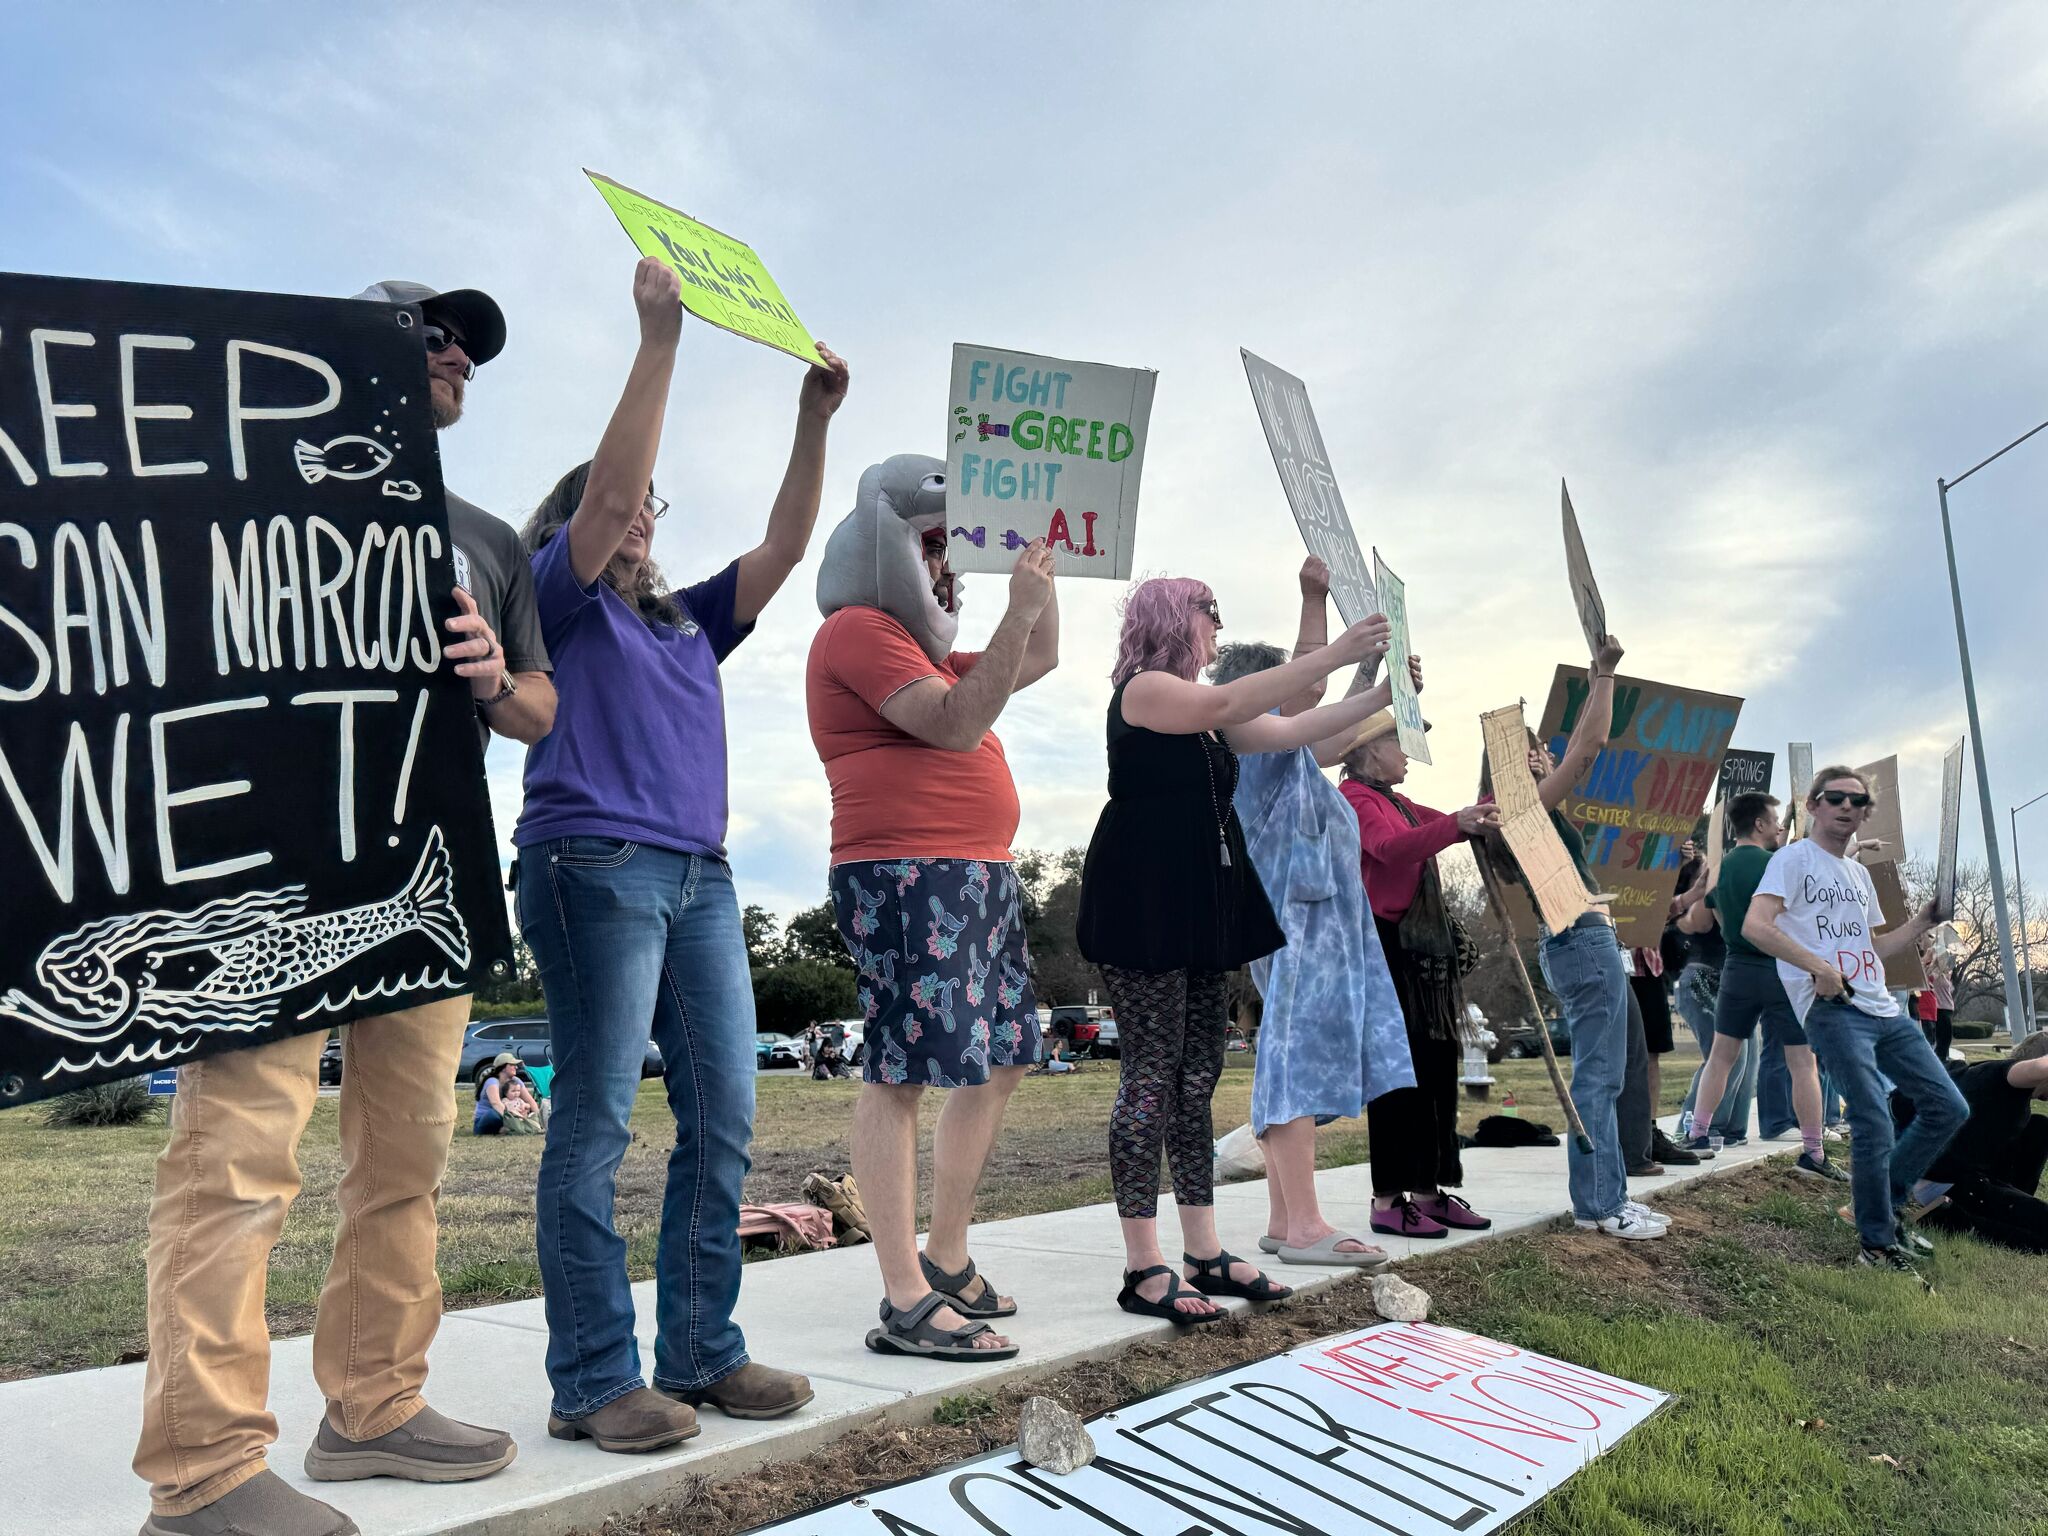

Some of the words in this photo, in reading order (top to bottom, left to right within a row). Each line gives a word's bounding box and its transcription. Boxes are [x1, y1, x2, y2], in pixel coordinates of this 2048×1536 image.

[647, 225, 708, 273] YOU
[674, 262, 740, 303] DRINK
[0, 329, 341, 486] EEP
[969, 360, 1073, 409] FIGHT
[1011, 410, 1134, 463] GREED
[960, 452, 1063, 502] FIGHT
[1282, 458, 1345, 531] NOT
[1045, 507, 1106, 557] A.I.
[1309, 524, 1365, 588] COMPLY
[211, 515, 441, 675] MARCOS
[1560, 676, 1641, 740] YU
[0, 689, 428, 903] WET!
[1722, 758, 1767, 783] SPRING
[1573, 802, 1631, 829] CENTER
[1299, 1321, 1521, 1411] MEETING
[1407, 1355, 1654, 1467] NOW
